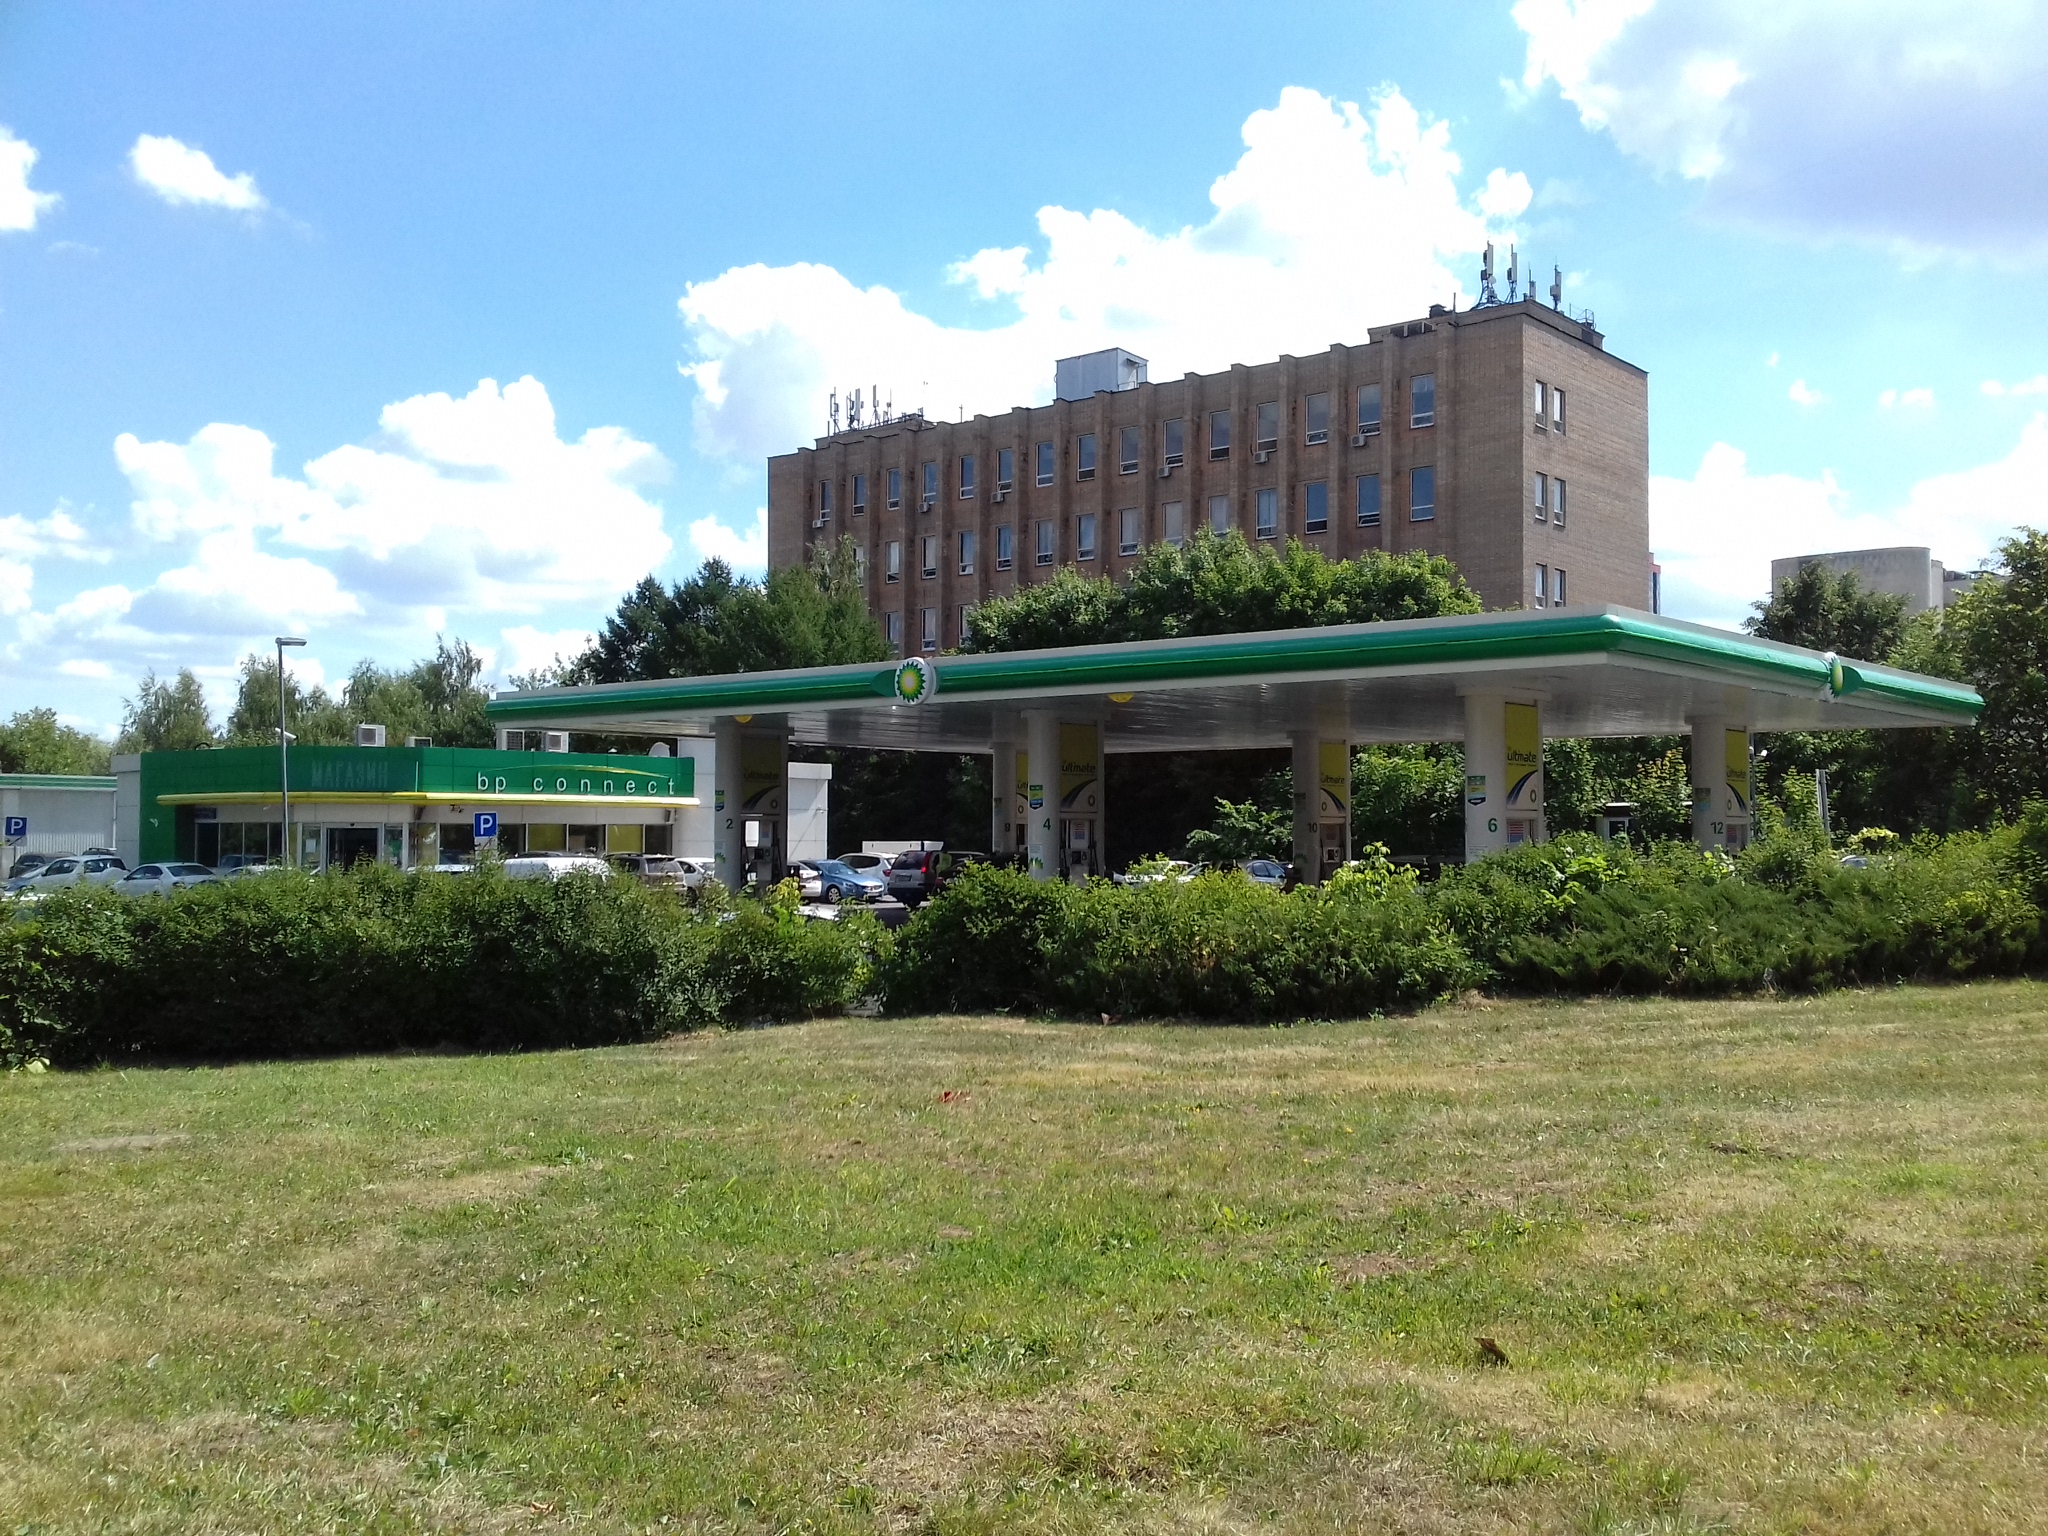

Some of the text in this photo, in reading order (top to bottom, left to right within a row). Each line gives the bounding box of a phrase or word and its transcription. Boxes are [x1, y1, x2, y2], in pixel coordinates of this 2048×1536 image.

[1507, 751, 1537, 762] ultimate
[1062, 762, 1096, 773] ultimate
[311, 761, 387, 788] МАГАЗИН
[477, 771, 675, 795] bp connect
[10, 818, 23, 834] P
[480, 815, 493, 835] P
[726, 818, 734, 829] 2
[1004, 823, 1011, 832] 8
[1043, 818, 1051, 831] 4
[1307, 822, 1318, 833] 10
[1488, 818, 1497, 832] 6
[1710, 822, 1724, 834] 12
